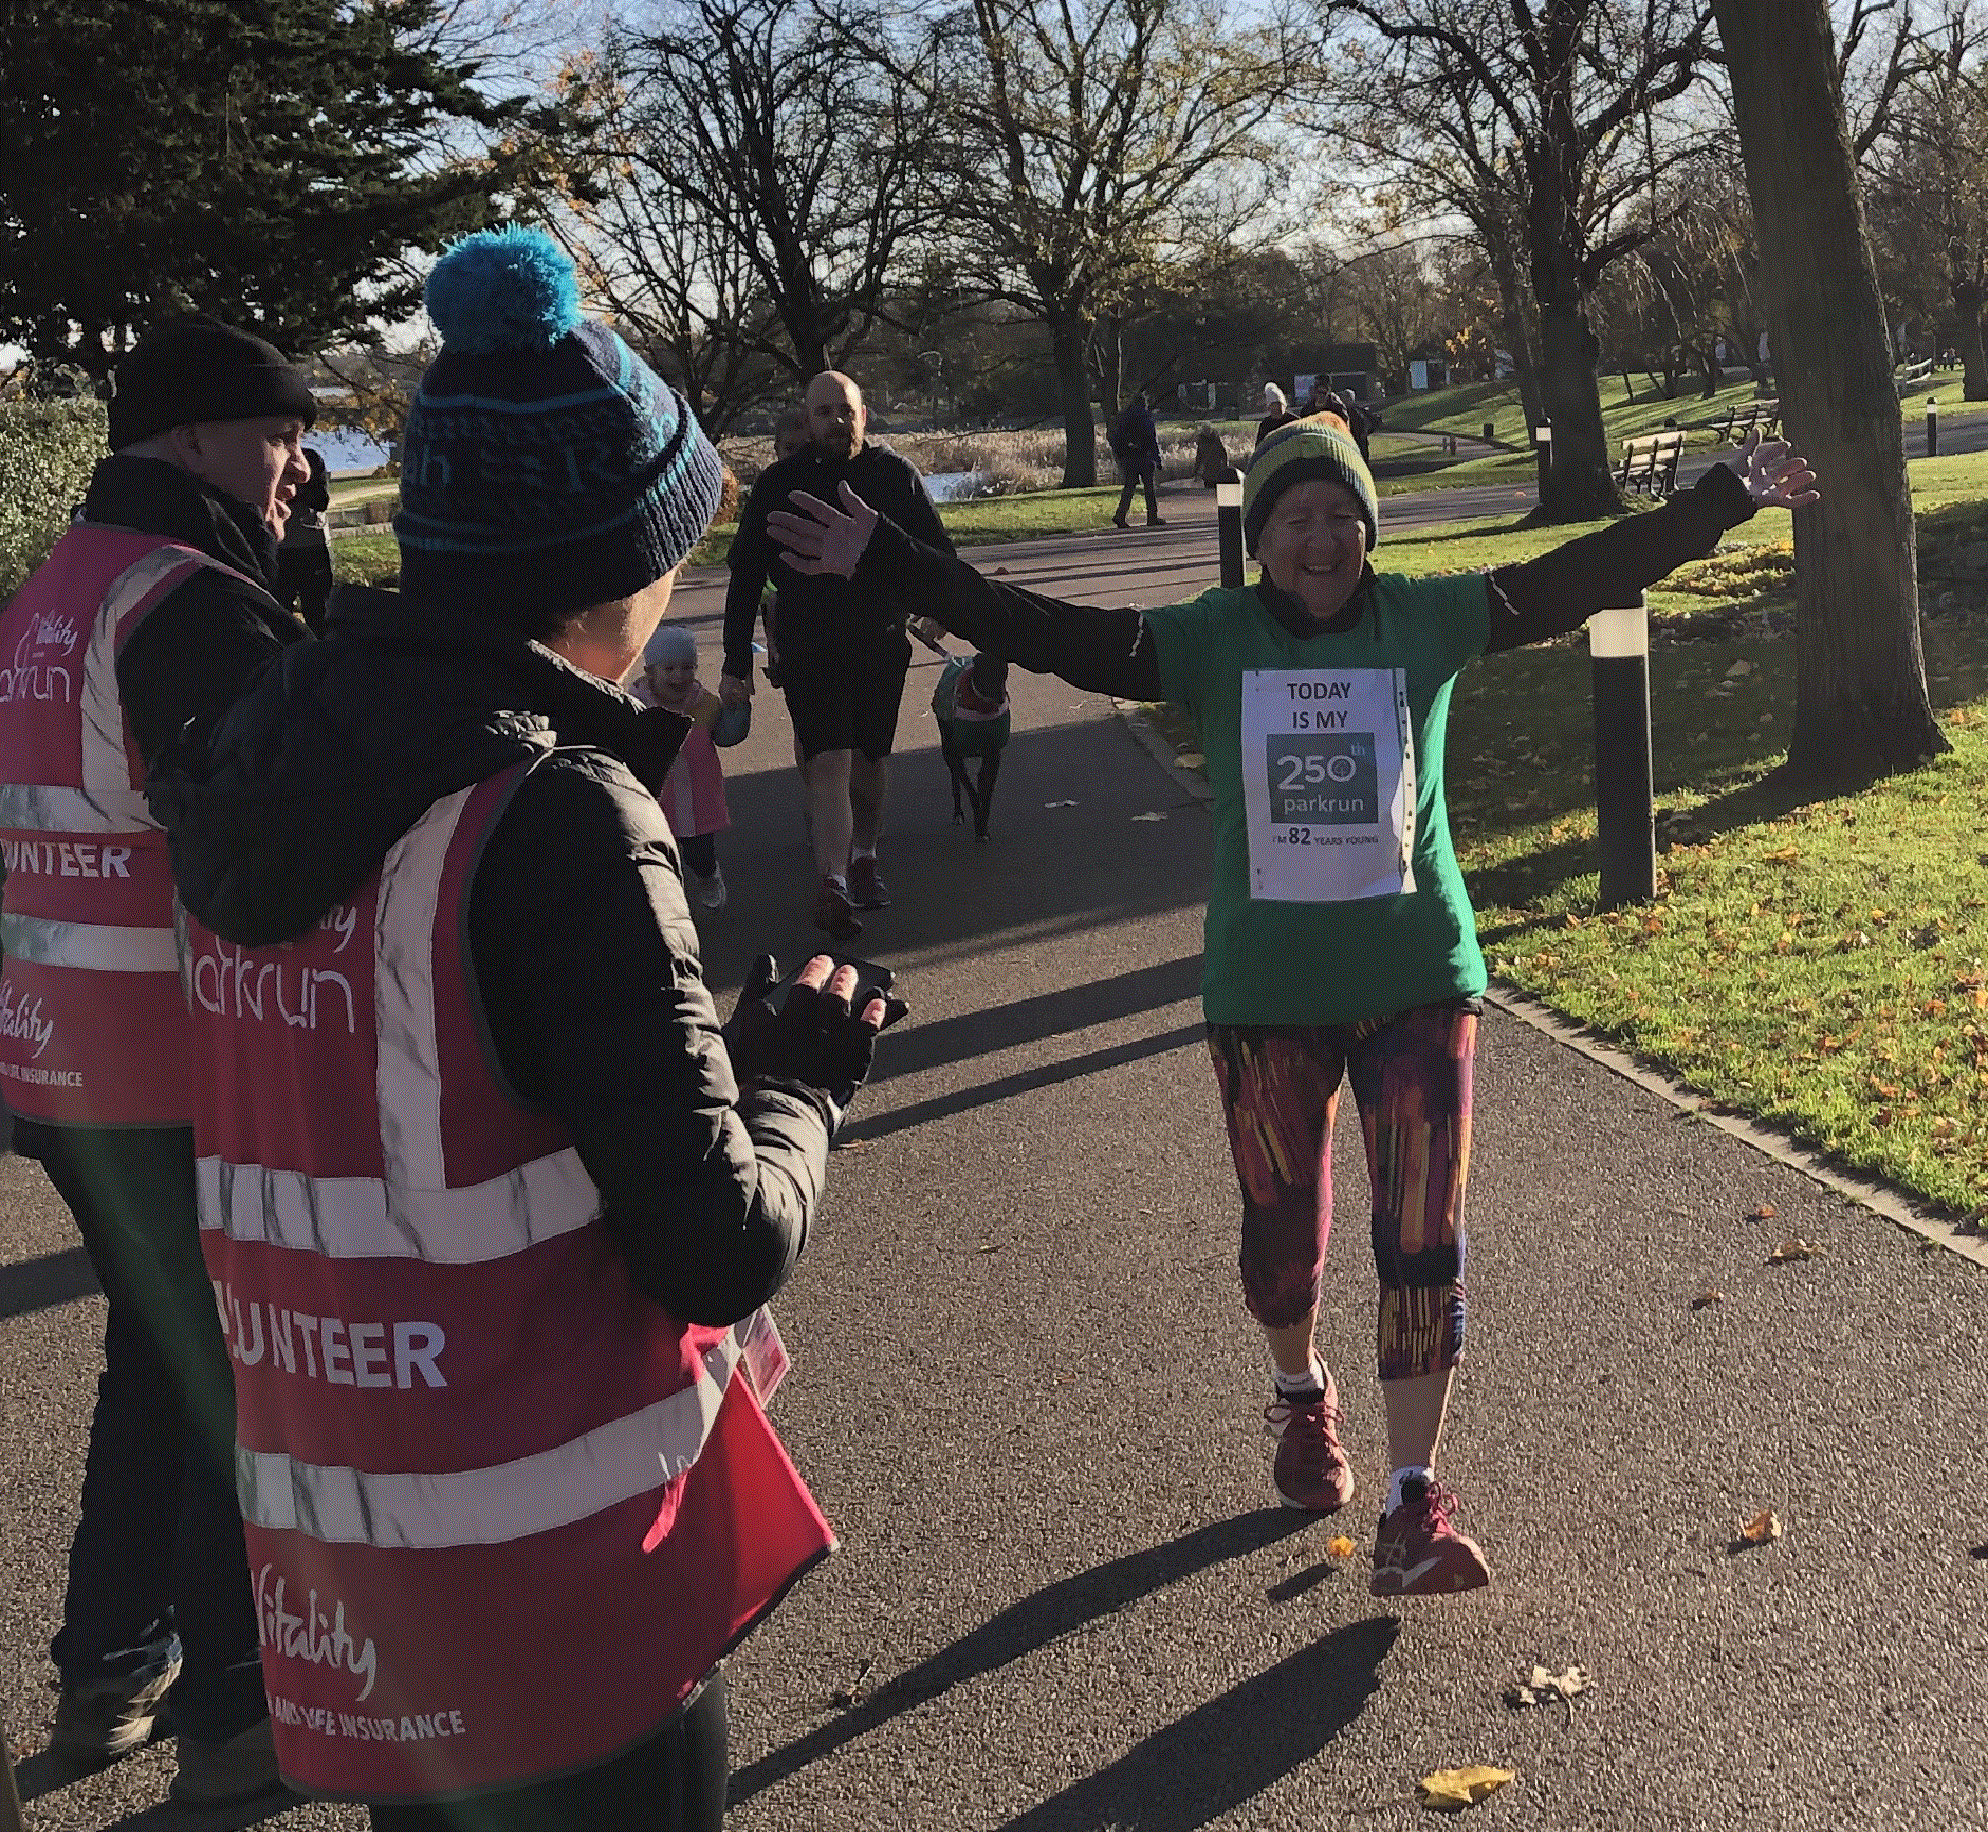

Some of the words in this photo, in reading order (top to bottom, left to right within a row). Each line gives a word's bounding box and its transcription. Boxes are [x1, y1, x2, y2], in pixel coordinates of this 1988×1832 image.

[1286, 682, 1351, 699] TODAY
[1292, 711, 1310, 729] IS
[1316, 710, 1348, 728] MY
[1284, 794, 1365, 815] parkrun
[1288, 827, 1311, 845] 82
[1313, 837, 1343, 846] YEARS
[1345, 835, 1379, 845] YOUNG
[0, 838, 132, 879] UNTEER
[194, 937, 355, 1034] arkrun
[251, 1562, 378, 1703] Vitality
[337, 1709, 467, 1743] INSURANCE
